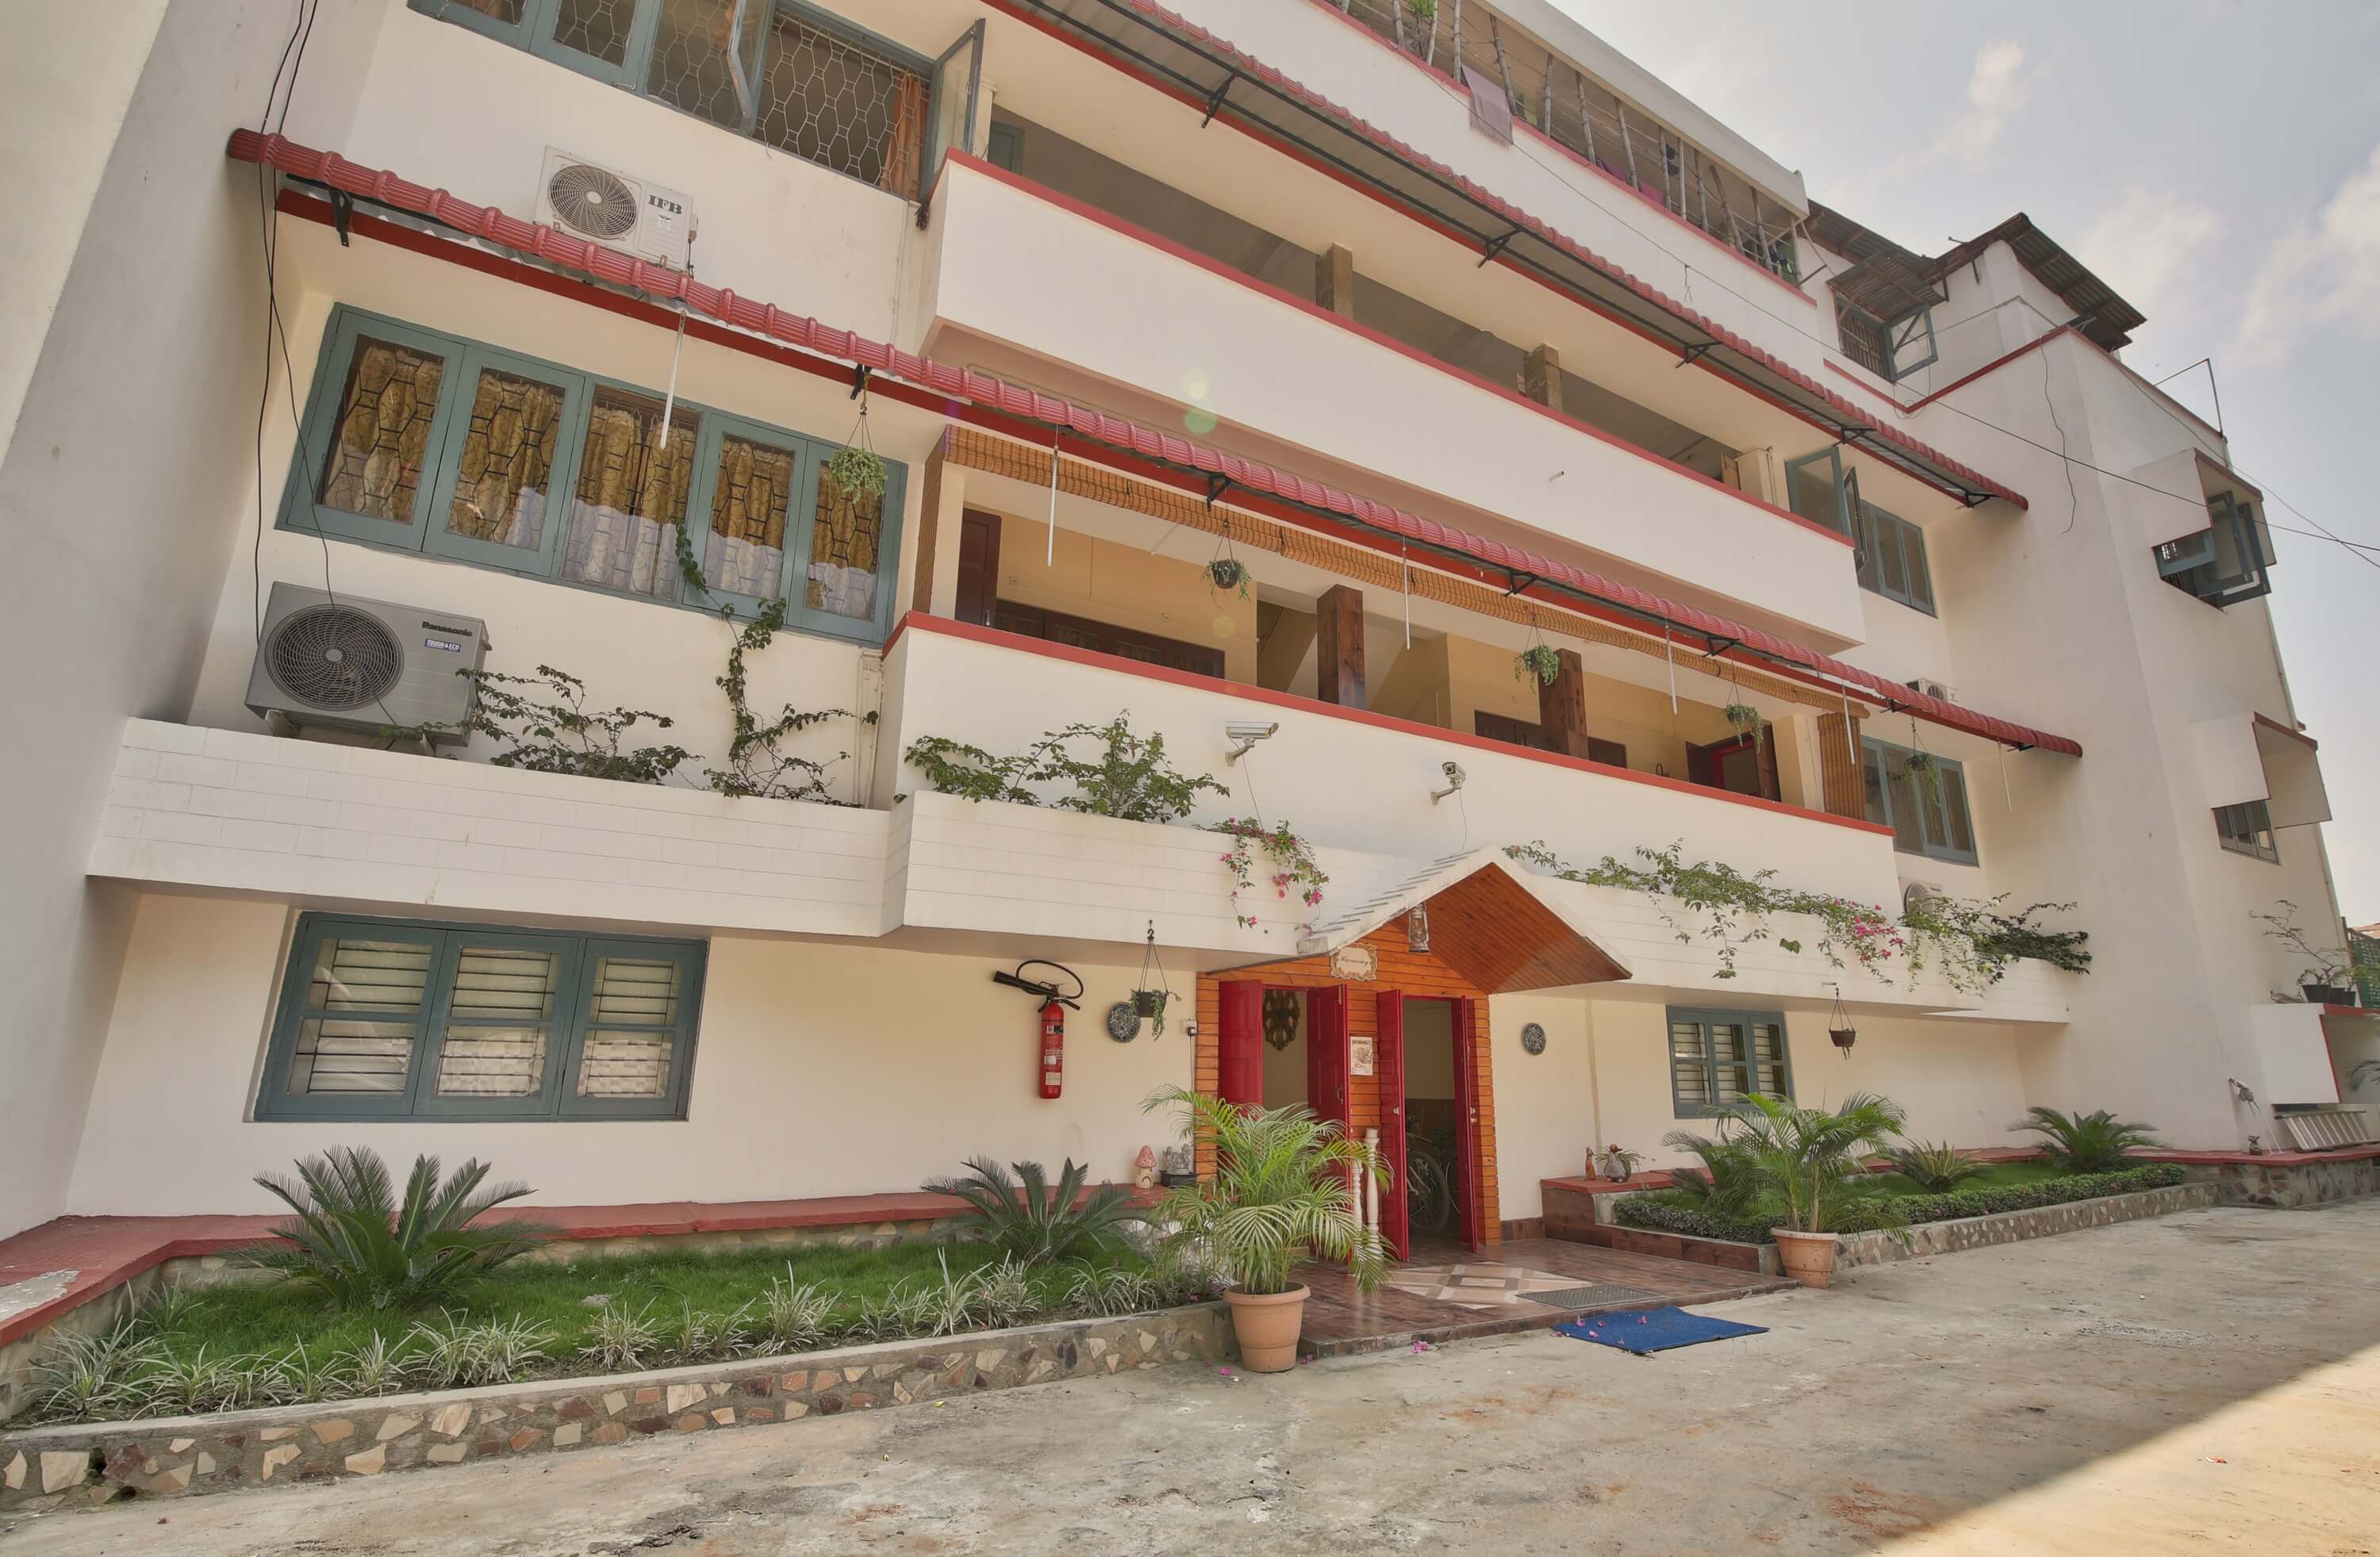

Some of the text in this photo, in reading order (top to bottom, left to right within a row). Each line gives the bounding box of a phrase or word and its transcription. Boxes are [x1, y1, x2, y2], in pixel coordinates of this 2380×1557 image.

[648, 194, 682, 215] IFB
[422, 621, 473, 637] Panasonic
[427, 639, 444, 648] TOUGH
